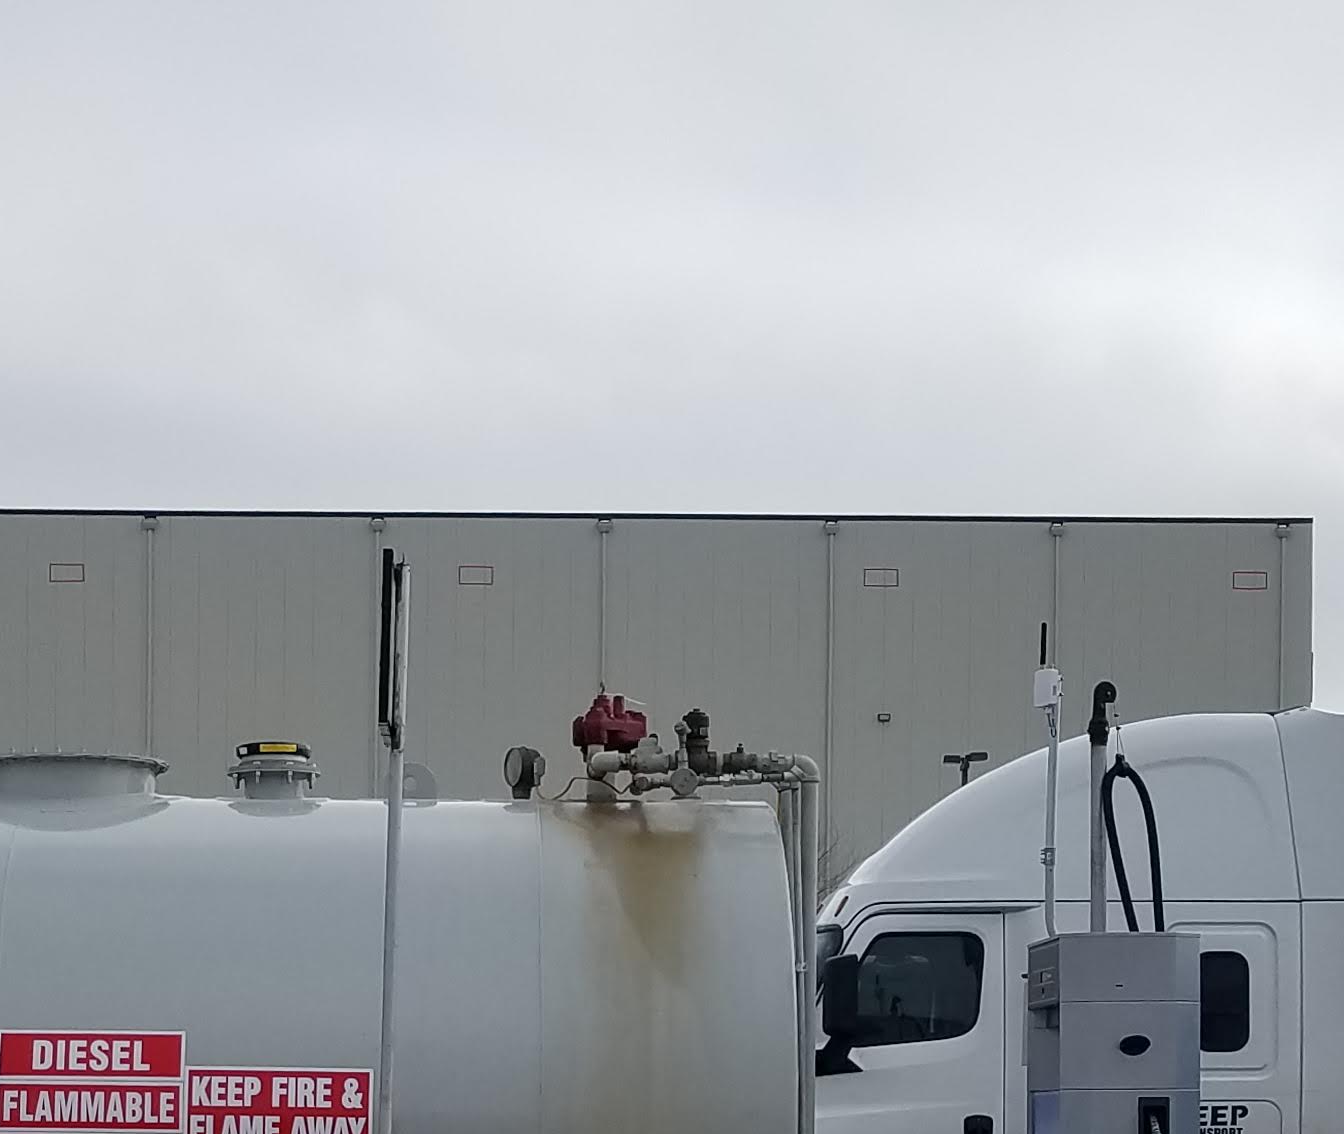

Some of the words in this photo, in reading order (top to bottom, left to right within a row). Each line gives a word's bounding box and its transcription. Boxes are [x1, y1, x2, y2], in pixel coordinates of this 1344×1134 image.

[31, 1039, 151, 1071] DIESEL
[2, 1089, 175, 1124] FLAMMABLE
[191, 1075, 262, 1107] KEEP
[271, 1076, 333, 1108] FIRE
[341, 1077, 363, 1109] &
